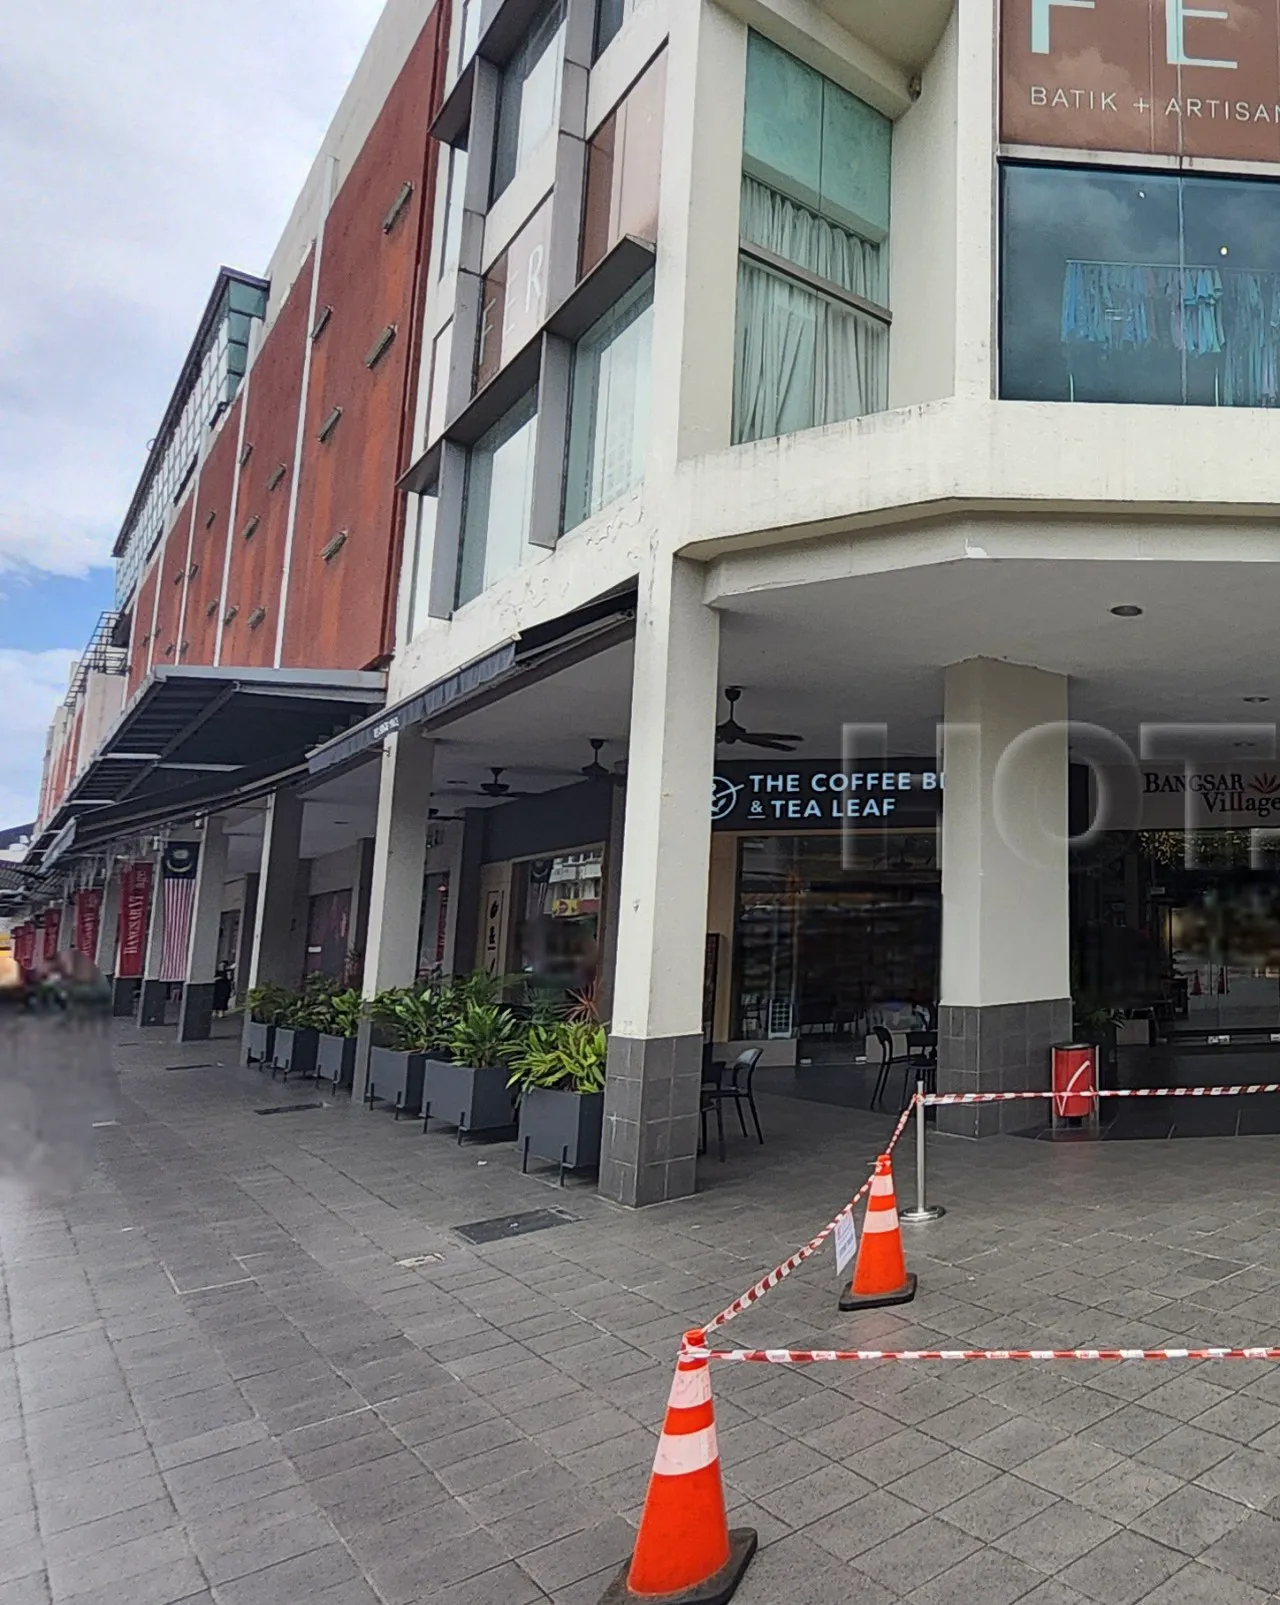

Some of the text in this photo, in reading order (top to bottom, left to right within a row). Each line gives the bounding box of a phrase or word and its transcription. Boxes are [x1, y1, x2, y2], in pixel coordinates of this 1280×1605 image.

[1031, 86, 1118, 113] BATIK
[1133, 98, 1151, 115] +
[749, 774, 800, 793] THE
[811, 772, 912, 792] COFFEE
[1143, 772, 1245, 793] BANGSAR
[750, 798, 896, 818] & TEA LEAF
